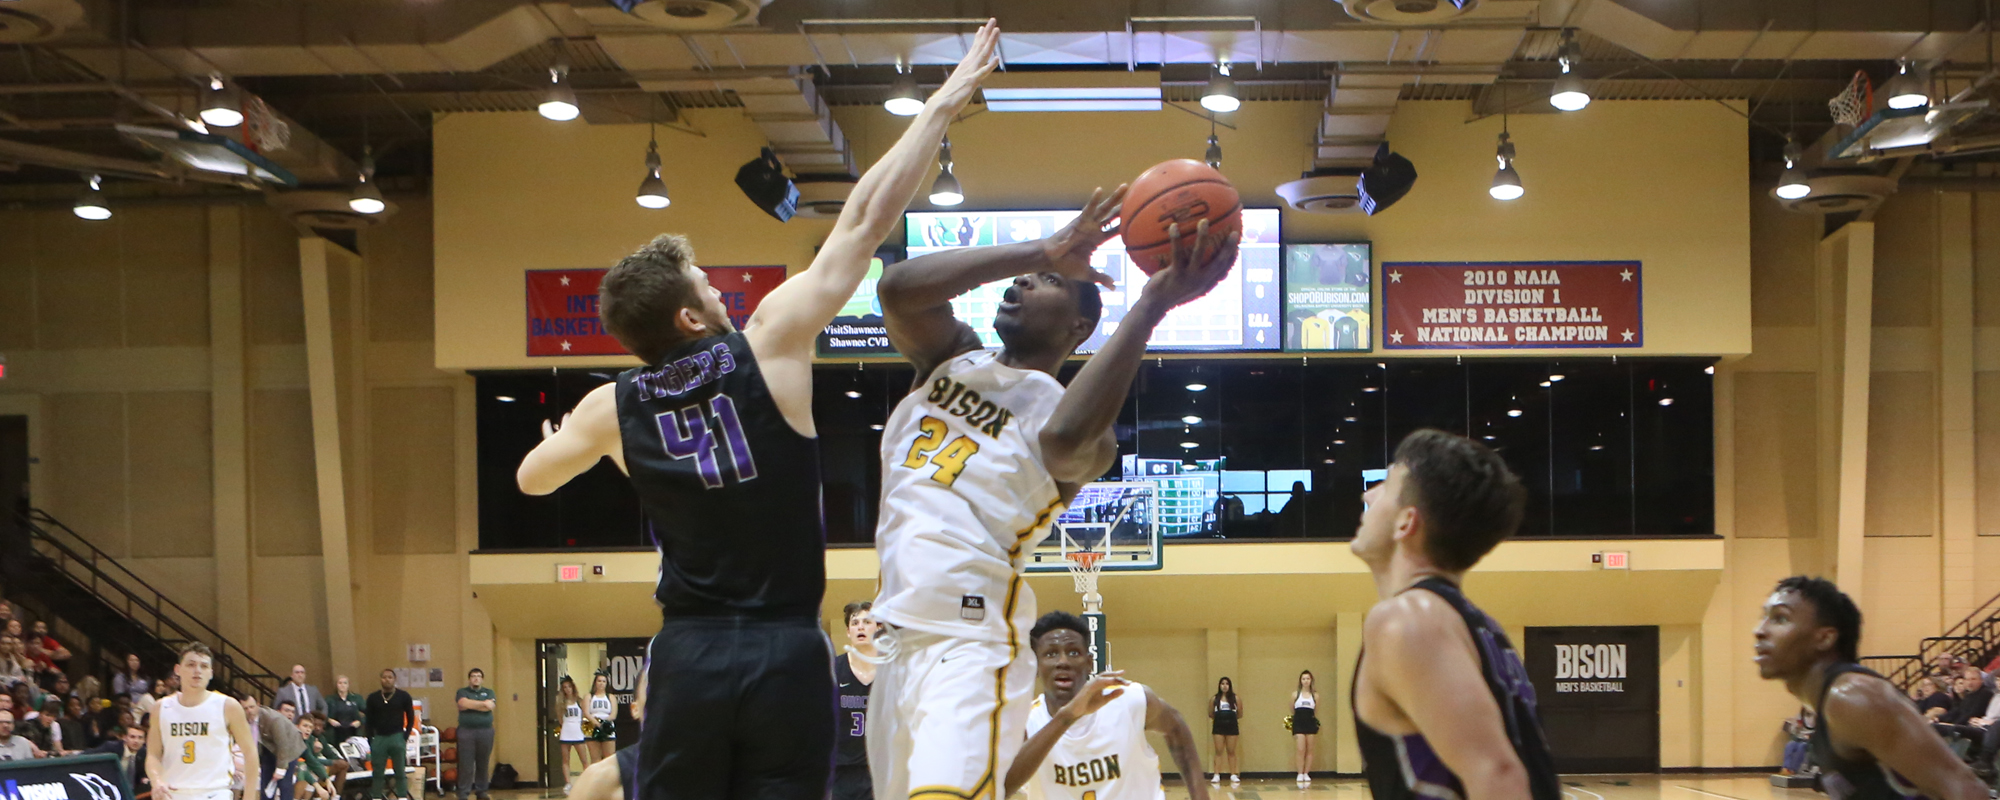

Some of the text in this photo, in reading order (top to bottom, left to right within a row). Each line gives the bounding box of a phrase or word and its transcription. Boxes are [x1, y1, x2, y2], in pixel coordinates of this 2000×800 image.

[1463, 270, 1561, 285] 2010 NAIA
[566, 292, 746, 314] INT TE
[1288, 291, 1369, 304] SHOPOBUBISON.COM
[1464, 289, 1561, 304] DIVISION 1
[1422, 307, 1602, 323] MEN'S BASKETBALL
[531, 318, 608, 336] BASKET
[1417, 326, 1608, 342] NATIONAL CHAMPION
[830, 336, 889, 348] Shawnee CVB
[631, 342, 737, 402] TIGERS
[927, 376, 1015, 440] BISON
[655, 393, 758, 489] 41
[901, 415, 980, 487] 24
[1608, 554, 1626, 566] EXIT
[562, 567, 579, 579] EXIT
[967, 598, 980, 607] XL
[1554, 644, 1627, 679] BISON
[606, 655, 643, 690] ON
[1556, 681, 1624, 692] MEN'S BASKETBALL
[840, 694, 868, 708] OUAC
[171, 722, 209, 737] BISON
[182, 740, 196, 764] 3
[1054, 754, 1121, 787] BISON
